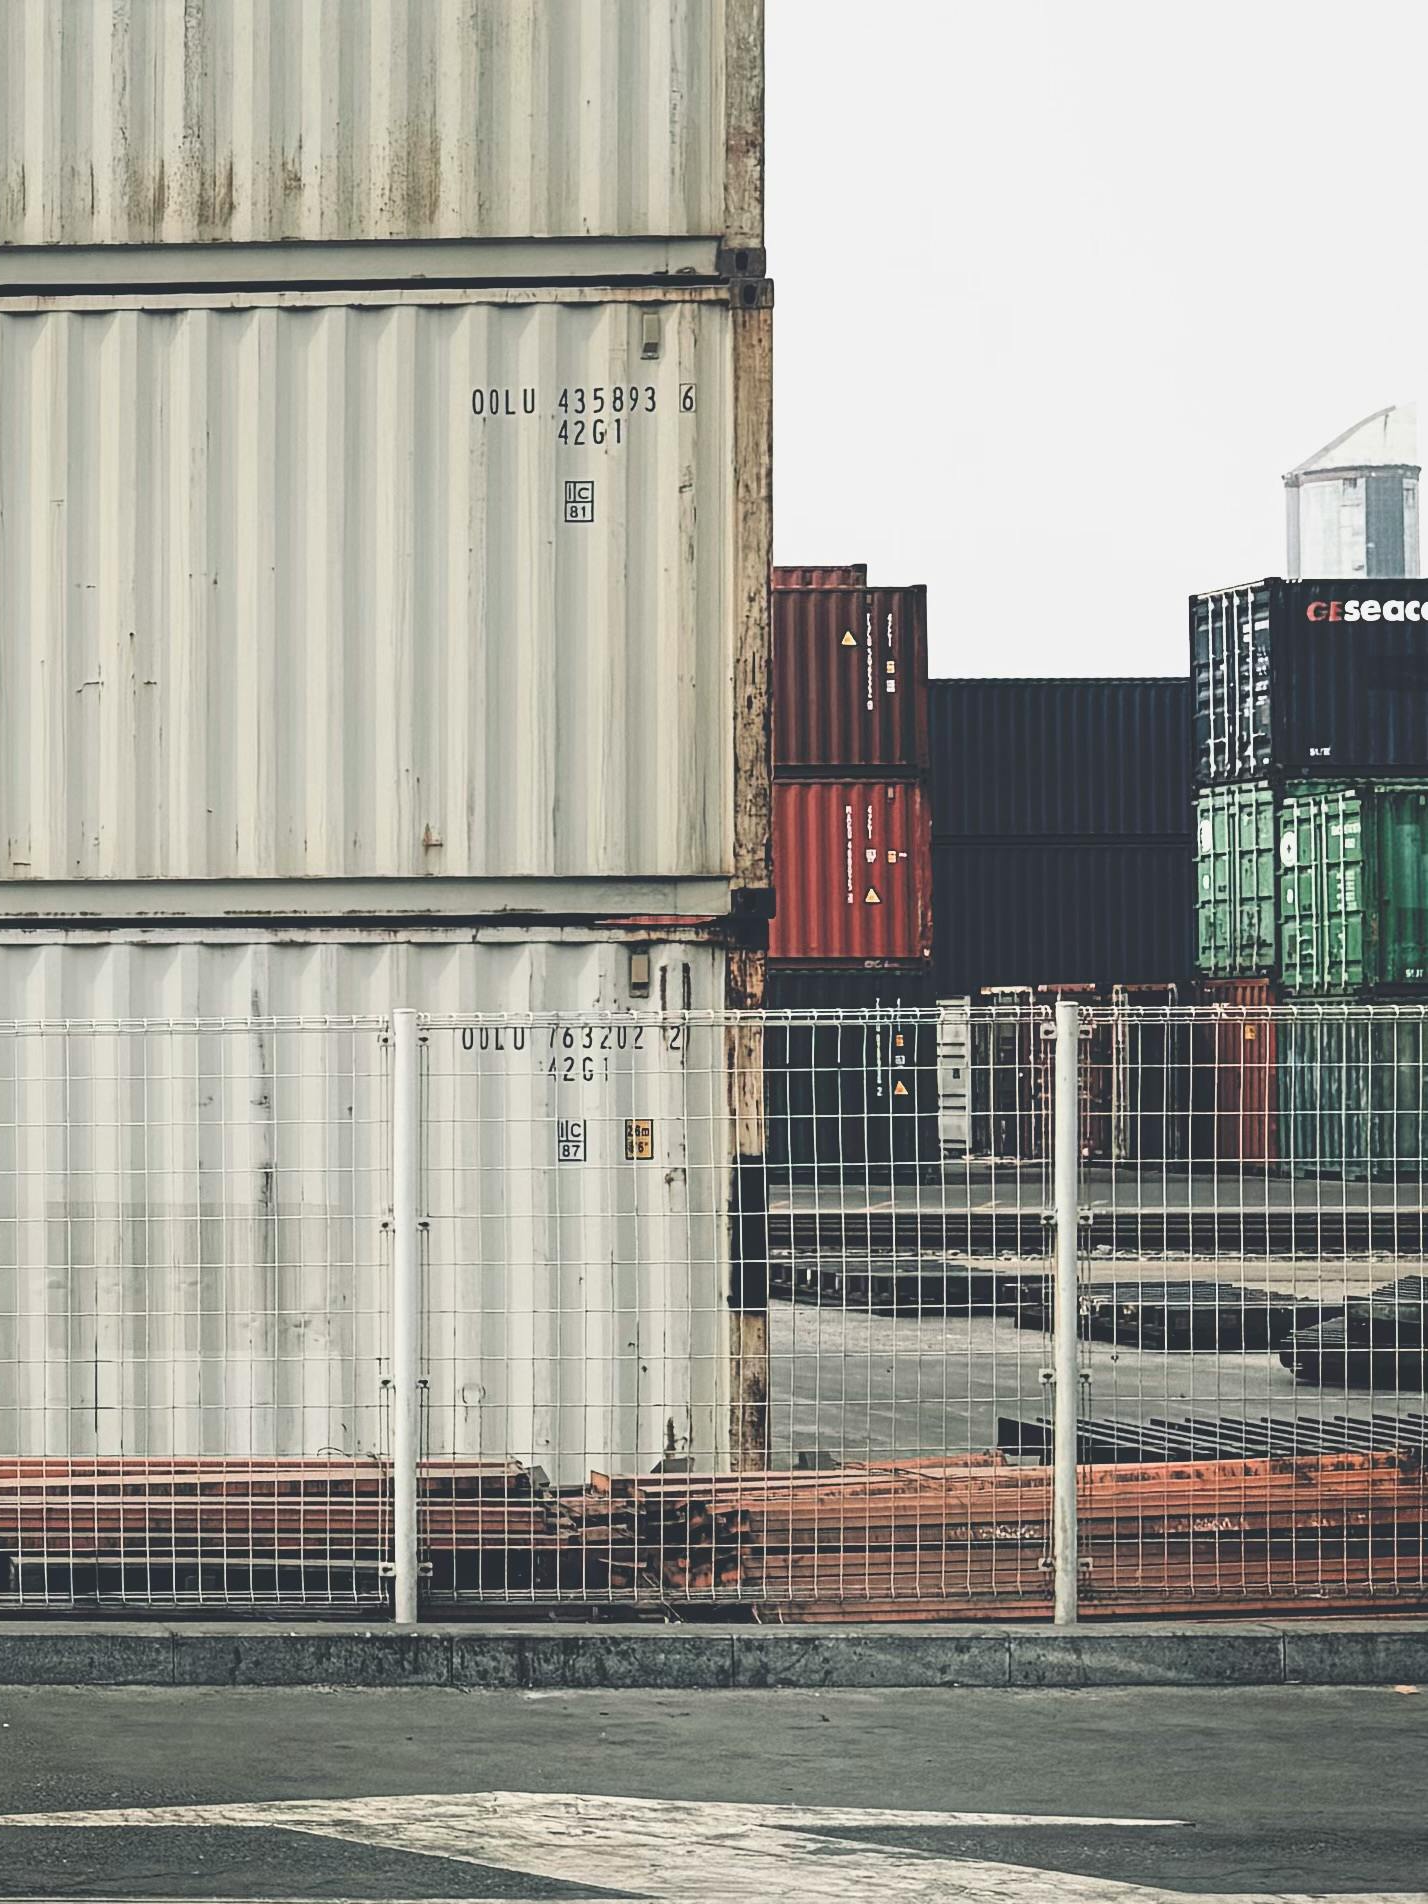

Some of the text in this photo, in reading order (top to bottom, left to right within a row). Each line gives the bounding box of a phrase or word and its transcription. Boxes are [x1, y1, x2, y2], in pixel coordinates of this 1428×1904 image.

[558, 386, 656, 414] 435893
[682, 385, 694, 411] 6
[558, 418, 621, 445] 42G1
[569, 505, 586, 519] 81
[547, 1023, 644, 1050] 763202
[547, 1055, 608, 1083] 42G1
[562, 1144, 581, 1158] 87
